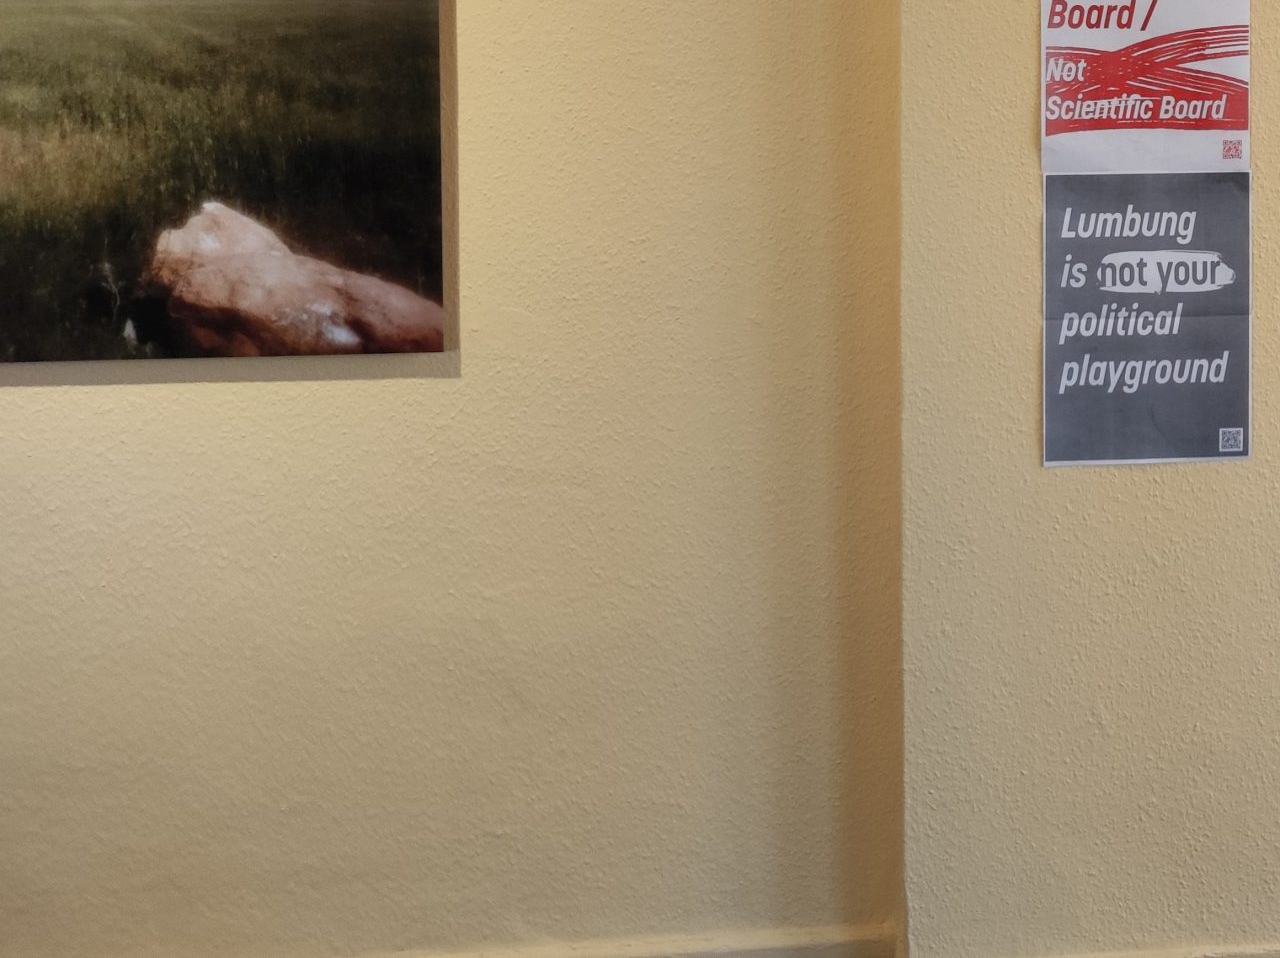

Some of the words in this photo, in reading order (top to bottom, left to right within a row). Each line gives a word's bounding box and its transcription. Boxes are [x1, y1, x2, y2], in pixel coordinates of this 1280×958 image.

[1045, 58, 1087, 82] Not
[1045, 93, 1153, 120] Scientific
[1159, 93, 1227, 120] Board
[1061, 204, 1197, 245] Lumbung
[1060, 253, 1088, 288] is
[1099, 257, 1148, 287] not
[1156, 258, 1221, 294] your
[1058, 302, 1184, 345] political
[1058, 350, 1229, 394] playground
